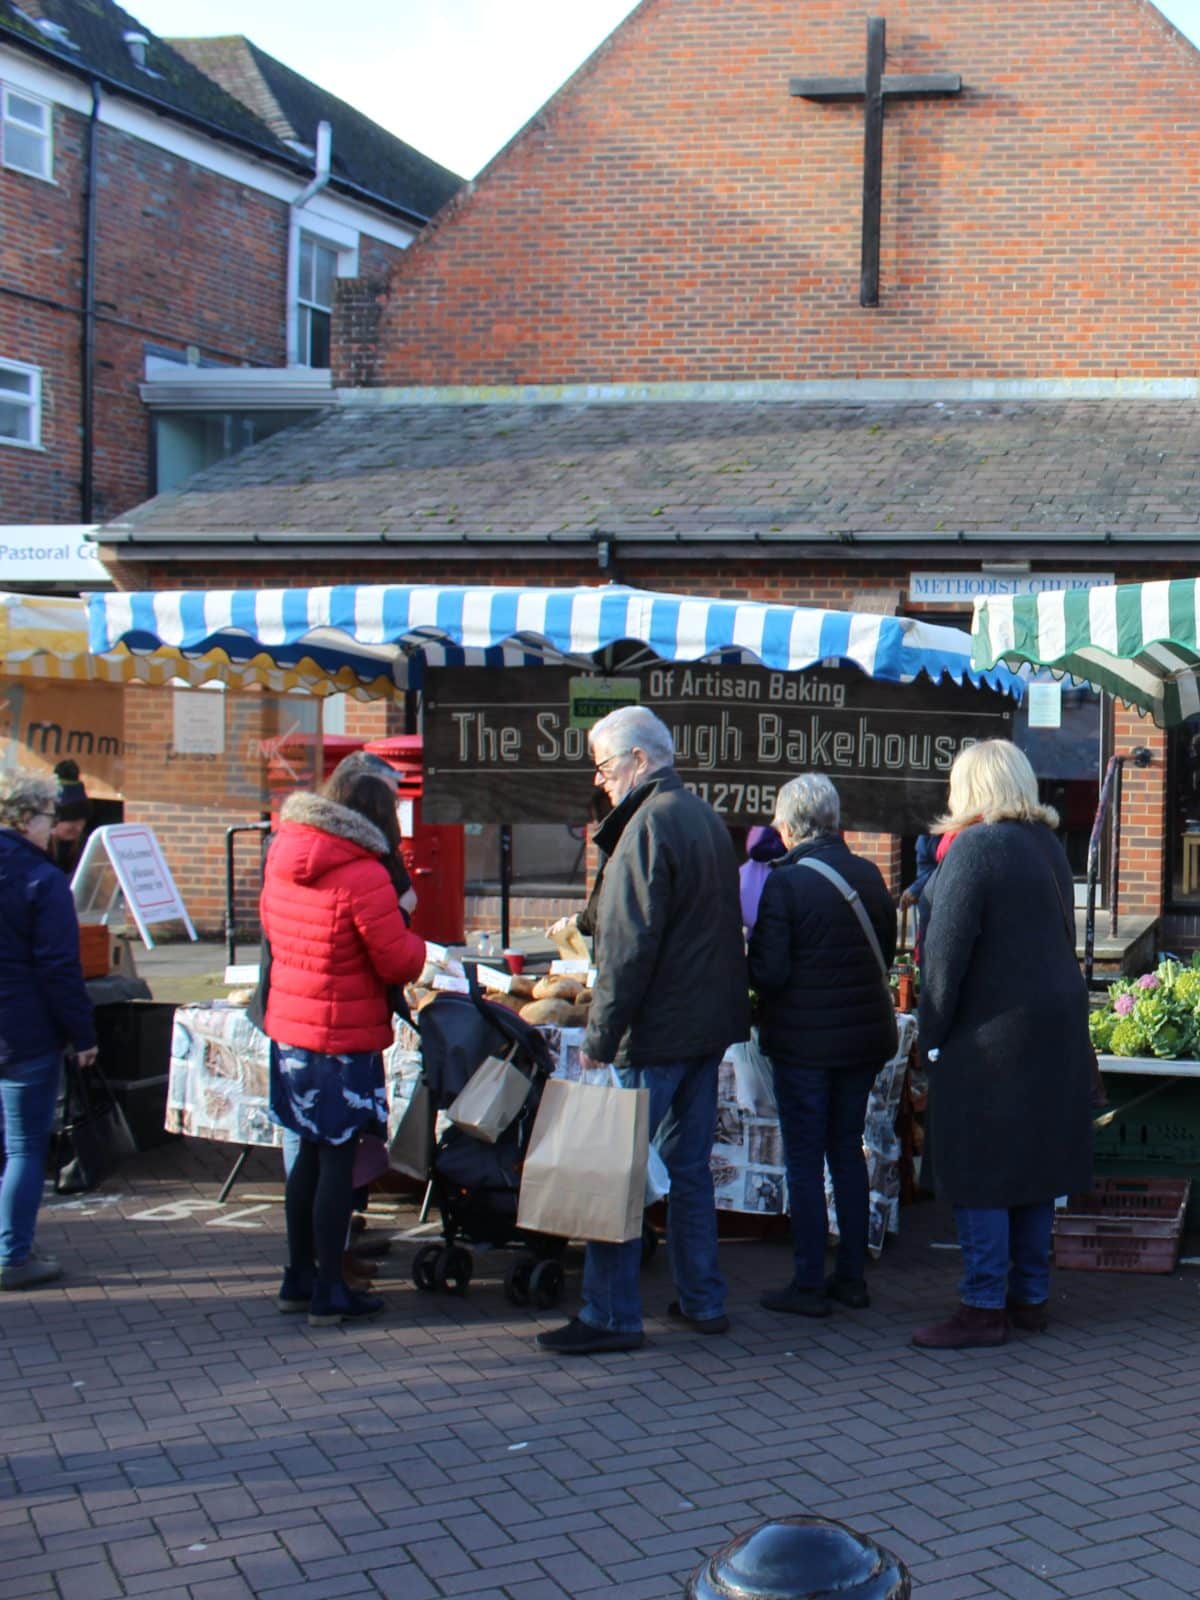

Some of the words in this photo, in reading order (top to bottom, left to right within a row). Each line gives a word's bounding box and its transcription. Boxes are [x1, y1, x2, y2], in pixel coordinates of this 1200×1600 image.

[0, 544, 70, 560] Pastoral
[914, 579, 1022, 594] METHODIST
[650, 669, 675, 697] Of
[680, 669, 760, 701] Artisan
[768, 676, 845, 708] Baking
[451, 712, 522, 762] The
[537, 711, 742, 769] Sough
